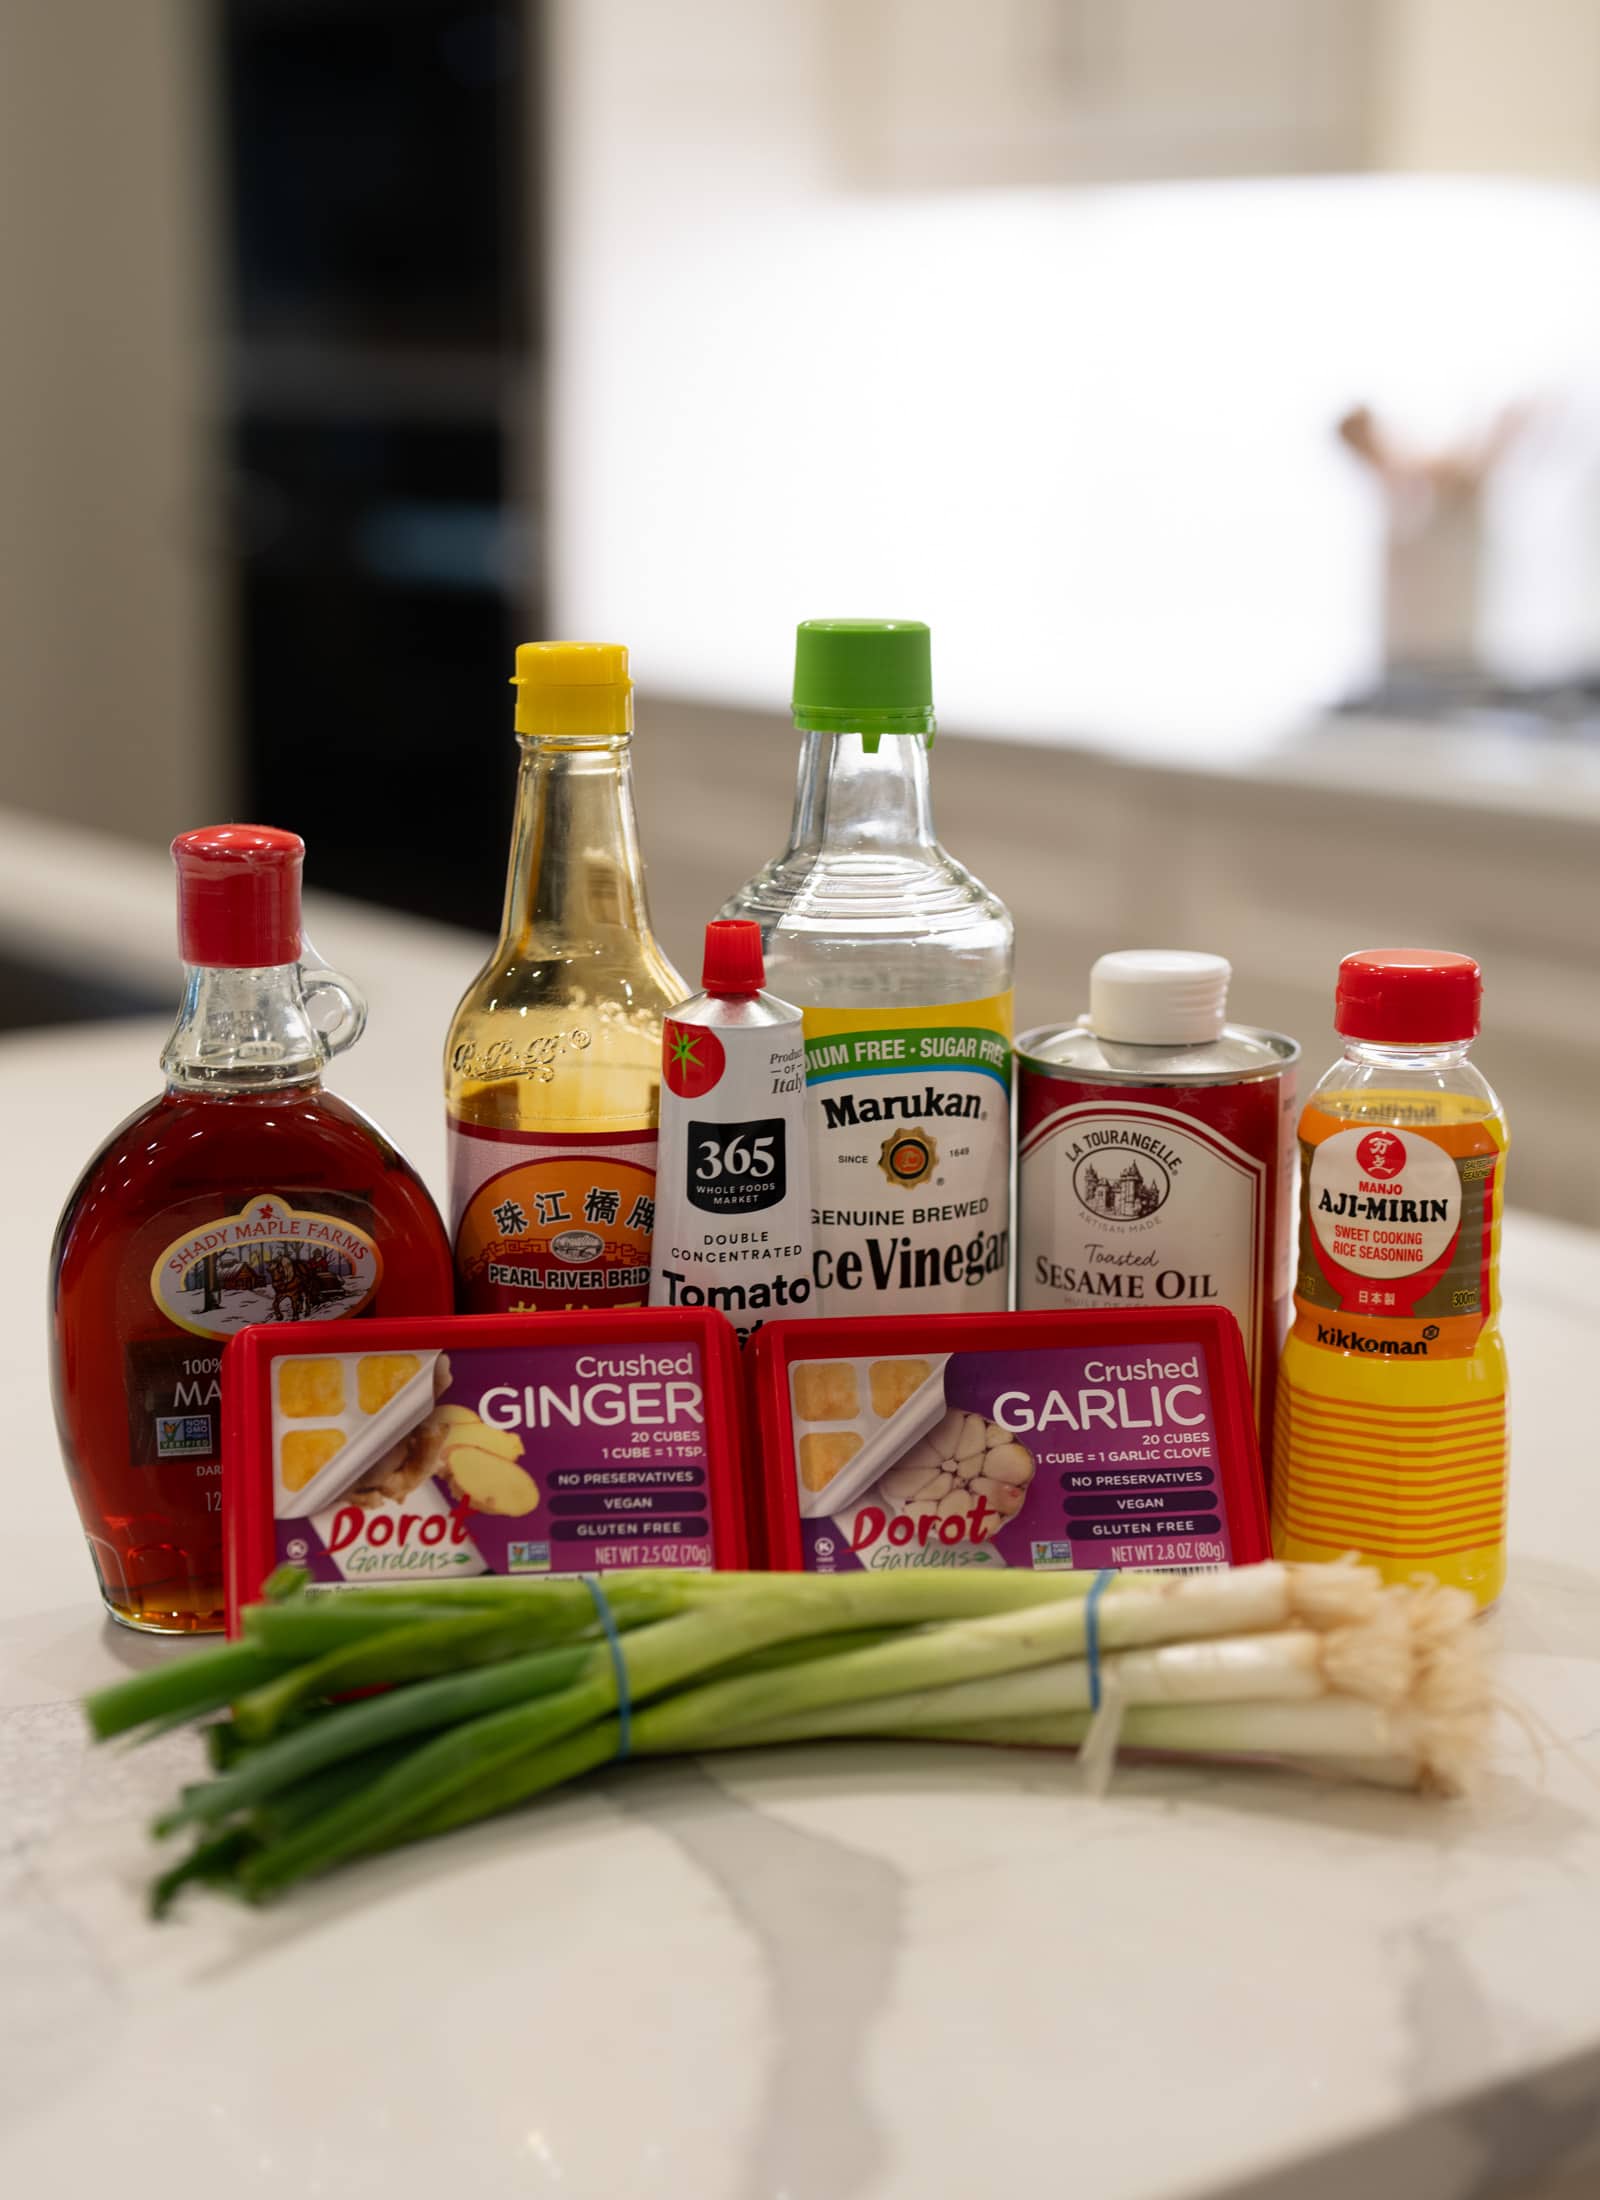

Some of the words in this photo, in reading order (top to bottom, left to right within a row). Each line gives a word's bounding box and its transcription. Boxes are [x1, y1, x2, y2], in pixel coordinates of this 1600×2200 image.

[770, 1048, 802, 1065] Produc
[805, 1044, 849, 1072] DIUM
[854, 1039, 906, 1062] FREE
[920, 1037, 977, 1058] SUGAR
[979, 1040, 1005, 1067] FREE
[784, 1065, 795, 1074] OF
[772, 1073, 802, 1095] Italy
[821, 1087, 982, 1129] Marukan
[696, 1135, 775, 1180] 365
[838, 1155, 868, 1164] SINCE
[1065, 1143, 1083, 1162] LA
[1083, 1130, 1183, 1170] TOURANGELLE
[696, 1185, 735, 1195] WHOLE
[739, 1182, 776, 1193] FOODS
[1359, 1181, 1403, 1195] MANJO
[713, 1194, 759, 1205] MARKET
[1318, 1188, 1449, 1223] AJI-MIRIN
[494, 1187, 656, 1236] 珠江橋牌
[811, 1209, 904, 1226] GENUINE
[913, 1198, 988, 1224] BREWED
[1078, 1212, 1125, 1234] ARTISAN
[1129, 1216, 1162, 1233] MADE
[704, 1232, 769, 1246] DOUBLE
[1335, 1224, 1370, 1243] SWEET
[1373, 1229, 1423, 1245] COOKING
[169, 1229, 228, 1274] SHADY
[235, 1221, 301, 1240] MAPLE
[308, 1223, 369, 1260] FARMS
[671, 1245, 803, 1263] CONCENTRATED
[1084, 1244, 1160, 1267] Toasted
[1333, 1240, 1357, 1258] RICE
[1359, 1243, 1423, 1262] SEASONING
[813, 1250, 862, 1290] ce
[865, 1230, 1009, 1290] Vinegar
[489, 1263, 544, 1288] PEARL
[546, 1270, 604, 1290] RIVER
[607, 1266, 650, 1288] BRID
[1035, 1255, 1144, 1299] SESAME
[1156, 1270, 1218, 1300] OIL
[662, 1269, 810, 1311] Tomato
[1358, 1290, 1396, 1306] 日本製
[1317, 1324, 1428, 1355] kikkoman
[182, 1358, 222, 1376] 100%
[575, 1352, 693, 1378] Crushed
[1084, 1357, 1199, 1383] Crushed
[478, 1381, 704, 1431] GINGER
[992, 1384, 1206, 1433] GARLIC
[631, 1432, 649, 1443] 20
[653, 1430, 701, 1442] CUBES
[1142, 1435, 1160, 1446] 20
[1163, 1432, 1210, 1445] CUBES
[602, 1448, 608, 1459] 1
[612, 1447, 651, 1459] CUBE
[666, 1446, 672, 1457] 1
[1036, 1453, 1042, 1464] 1
[1046, 1452, 1084, 1464] CUBE
[1099, 1452, 1105, 1463] 1
[1108, 1449, 1160, 1463] GARLIC
[1163, 1447, 1211, 1460] CLOVE
[196, 1466, 223, 1477] DAR
[558, 1473, 579, 1485] NO
[584, 1471, 693, 1485] PRESERVATIVES
[1071, 1475, 1092, 1487] NO
[1096, 1471, 1203, 1487] PRESERVATIVES
[604, 1496, 652, 1509] VEGAN
[1116, 1497, 1164, 1510] VEGAN
[318, 1493, 480, 1557] Dorot
[577, 1522, 638, 1536] GLUTEN
[643, 1521, 682, 1534] FREE
[841, 1495, 996, 1553] Dorot
[1092, 1522, 1151, 1537] GLUTEN
[1156, 1519, 1194, 1533] FREE
[346, 1542, 452, 1573] Gardens
[595, 1546, 620, 1565] NET
[620, 1546, 639, 1564] WT
[641, 1545, 660, 1564] 2.5
[664, 1545, 678, 1563] OZ
[680, 1544, 711, 1566] (70g)
[870, 1541, 972, 1571] Gardens
[1111, 1546, 1133, 1562] NET
[1135, 1544, 1153, 1562] WT
[1157, 1544, 1175, 1561] 2.8
[1177, 1543, 1192, 1559] OZ
[1195, 1541, 1225, 1561] (80g)
